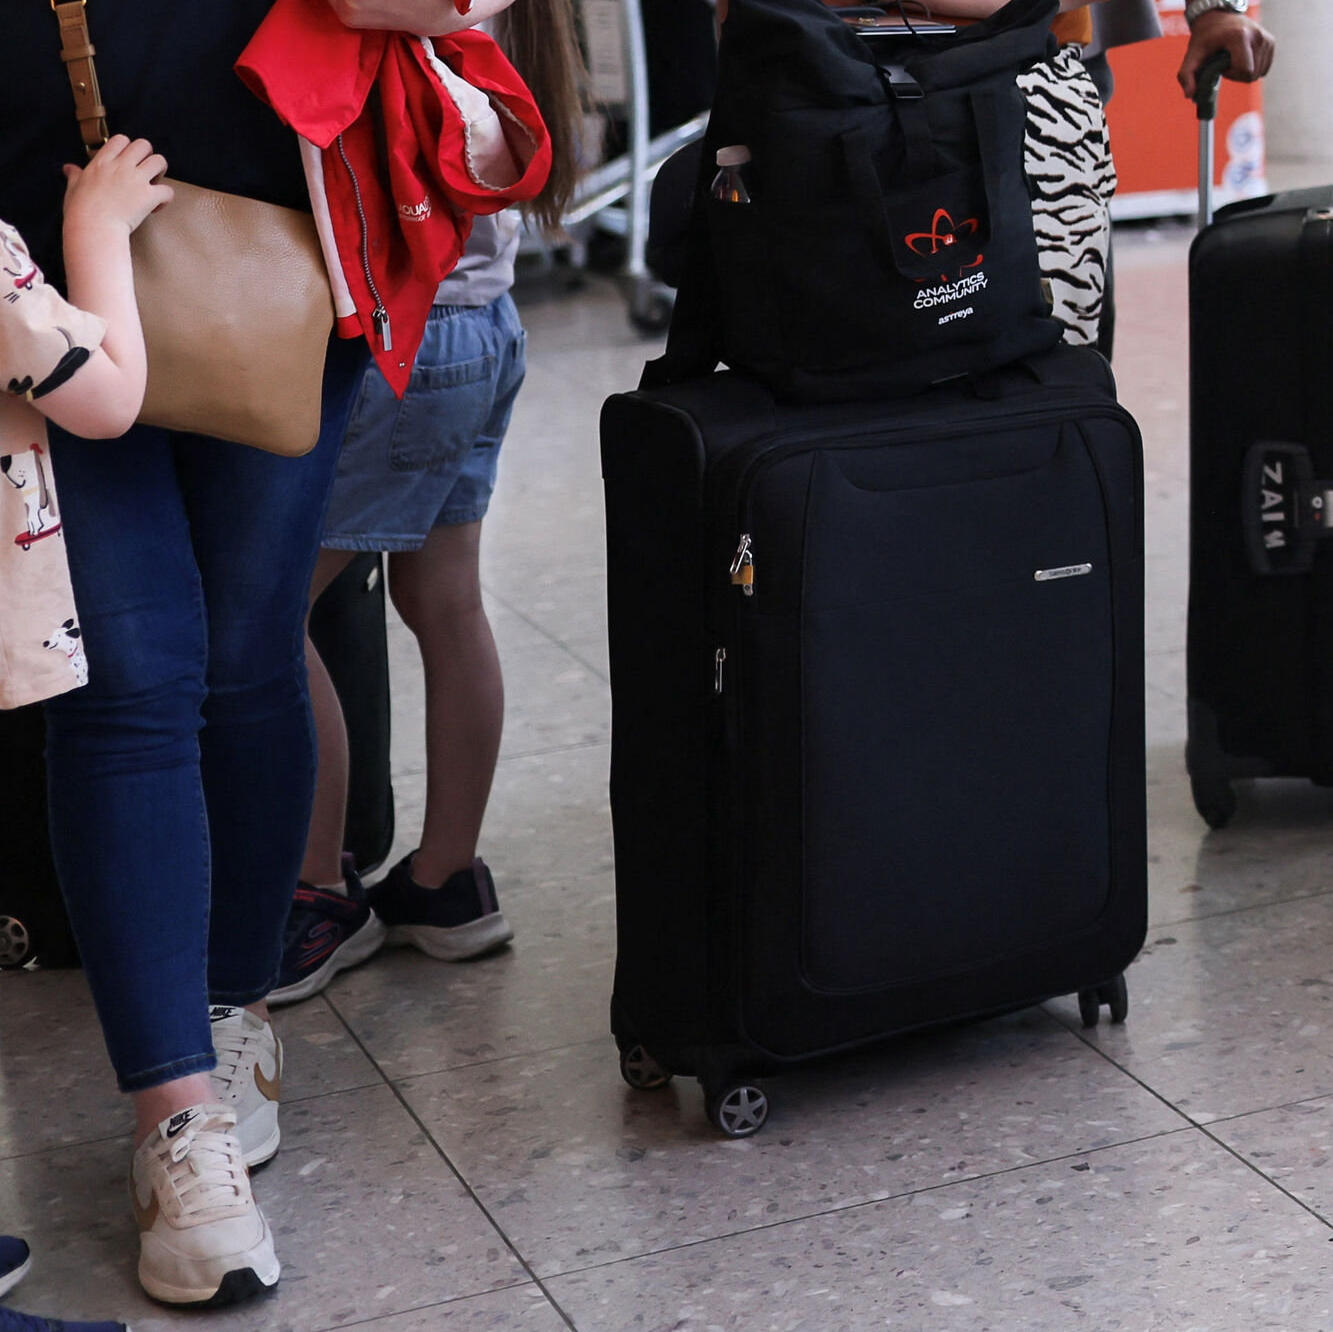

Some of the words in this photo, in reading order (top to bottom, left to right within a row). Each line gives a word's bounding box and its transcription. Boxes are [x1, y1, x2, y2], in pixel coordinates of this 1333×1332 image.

[913, 278, 988, 309] COMMUNITY
[916, 271, 985, 300] ANALYTICS
[938, 307, 974, 325] astreya
[169, 1108, 194, 1128] NIKE
